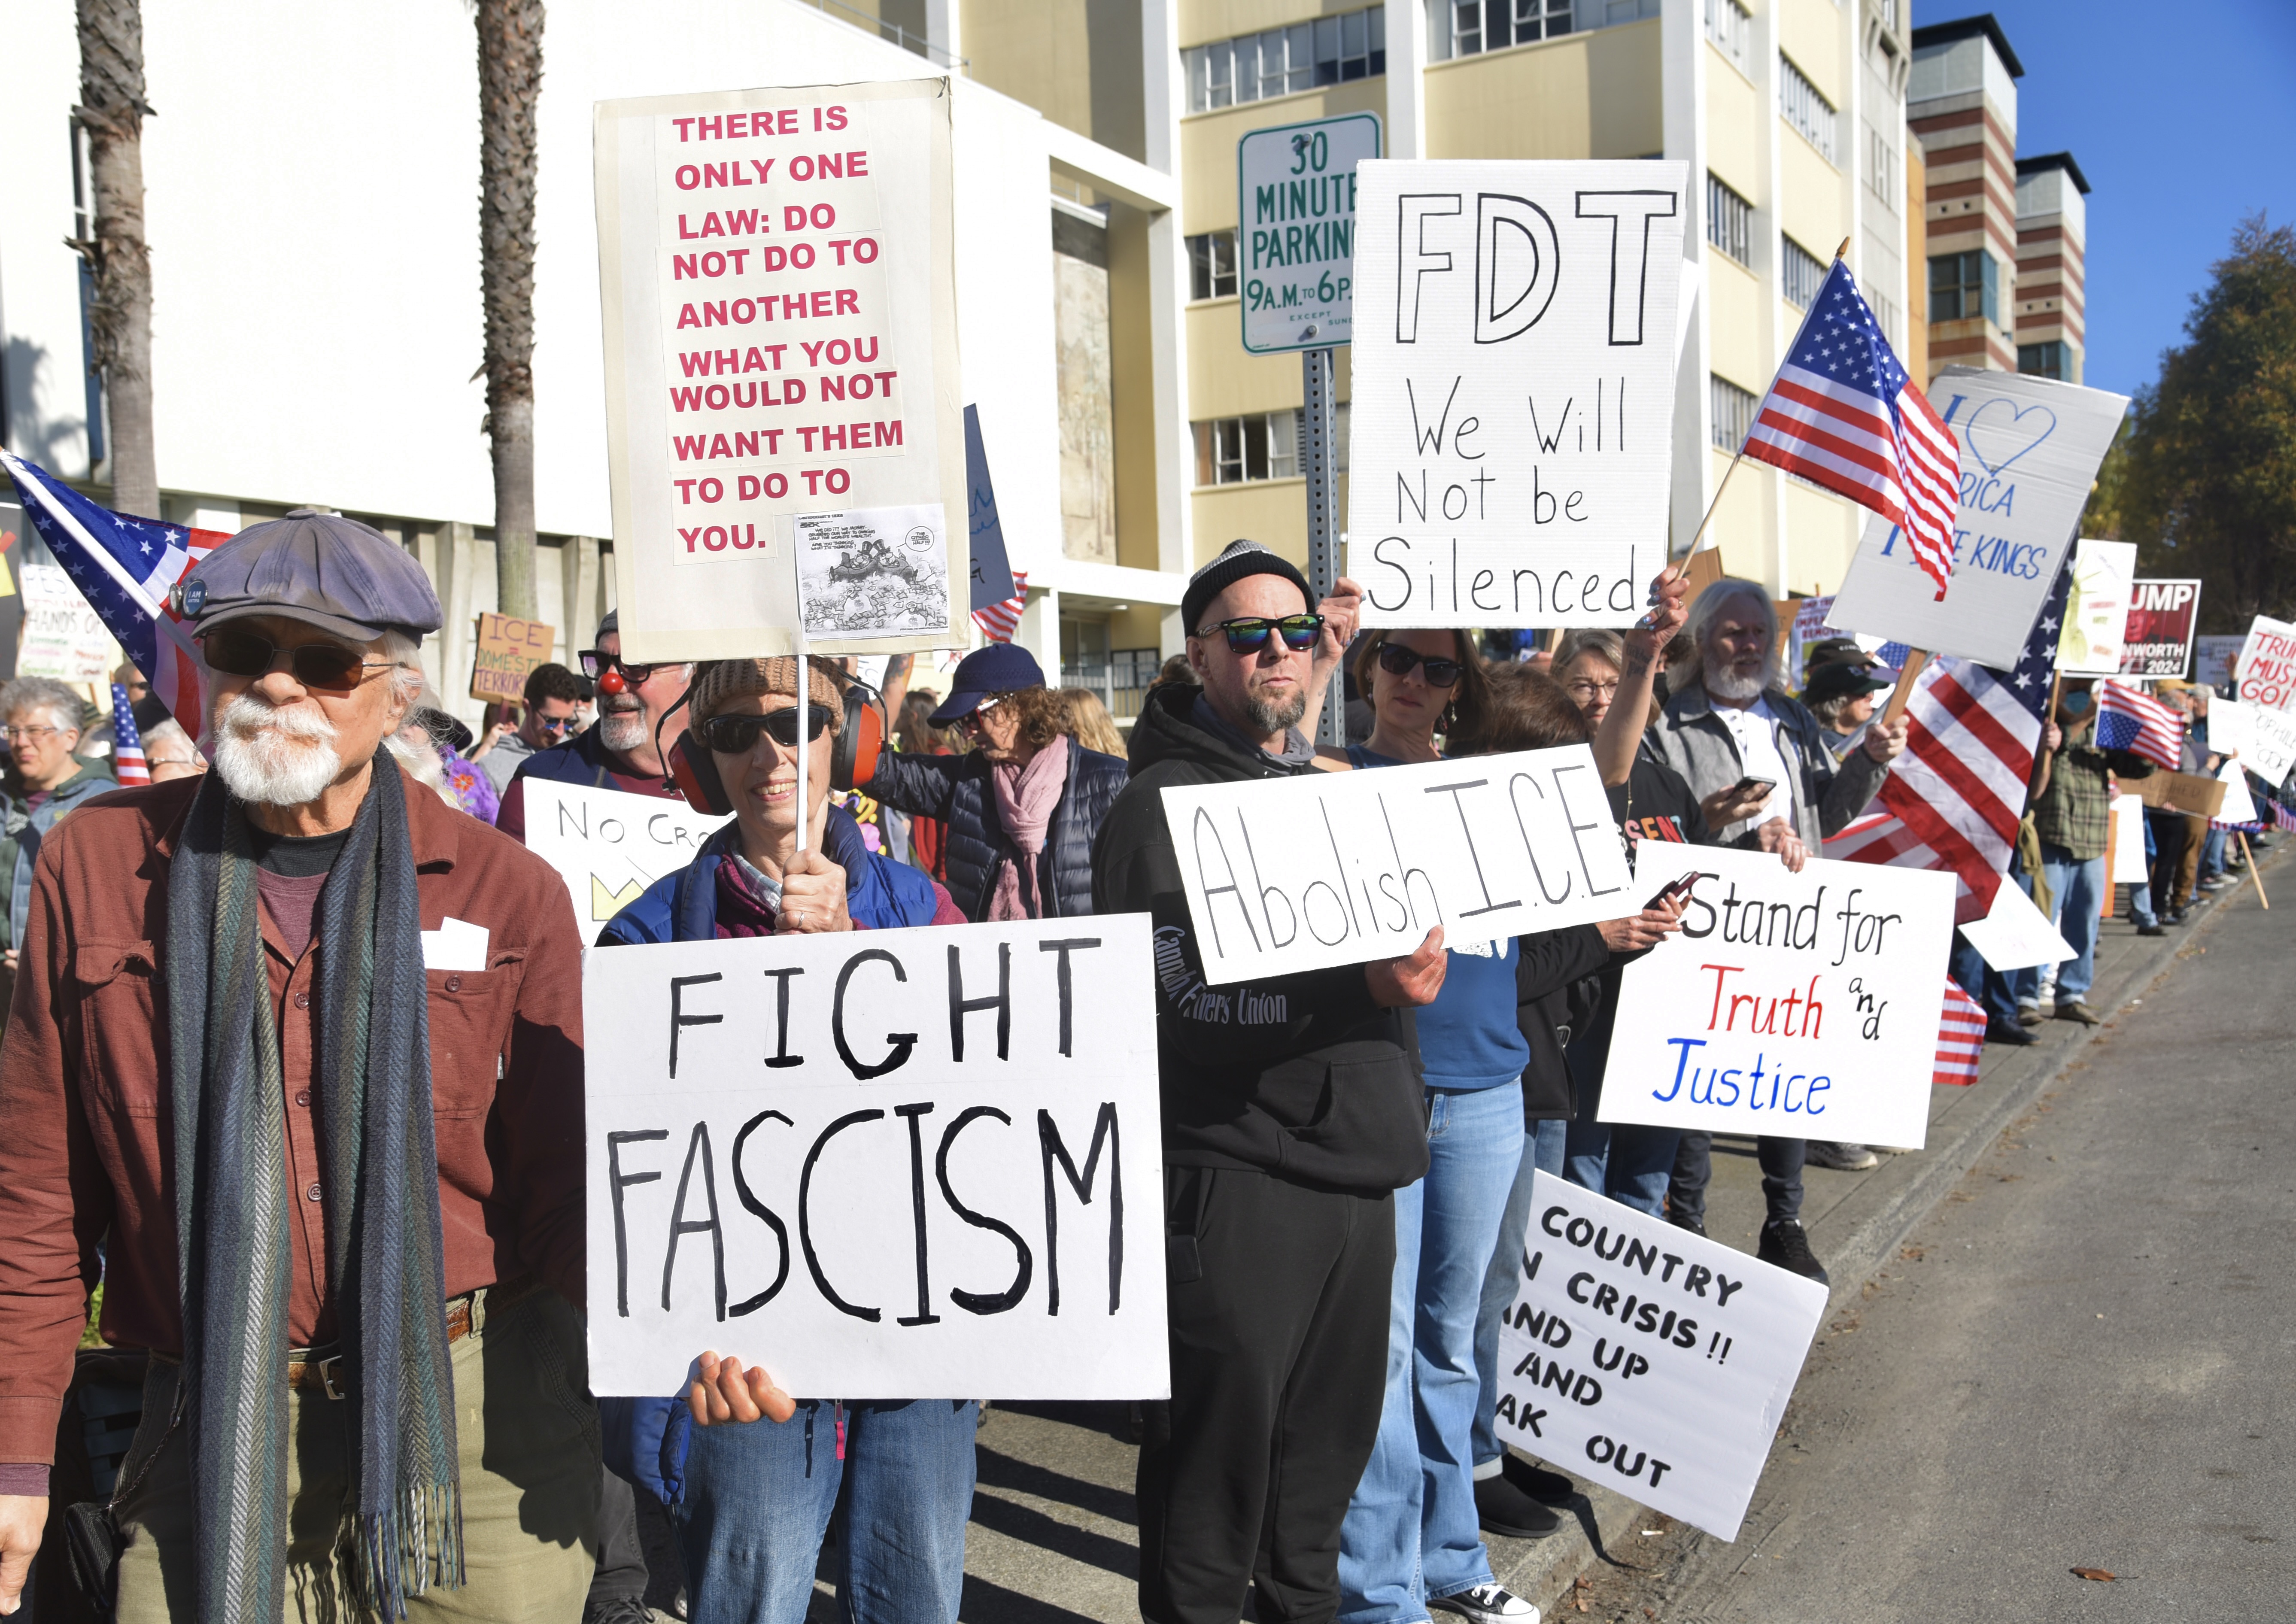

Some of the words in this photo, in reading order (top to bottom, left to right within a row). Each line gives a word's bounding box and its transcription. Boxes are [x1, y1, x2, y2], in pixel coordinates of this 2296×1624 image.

[673, 110, 798, 142] THERE
[814, 106, 847, 131] IS
[676, 159, 774, 190] ONLY
[790, 152, 868, 181] ONE
[1291, 132, 1327, 174] 30
[679, 209, 768, 239] LAW:
[785, 204, 835, 231] DO
[674, 249, 749, 279] NOT
[765, 244, 815, 271] DO
[829, 238, 878, 265] TO
[1253, 219, 1355, 270] PARKIN
[1396, 190, 1677, 346] FDT
[678, 290, 859, 328] ANOTHER
[1302, 288, 1315, 299] TO
[1289, 311, 1331, 321] EXCEPT
[680, 345, 787, 377] WHAT
[801, 337, 878, 366] YOU
[671, 379, 806, 412] WOULD
[821, 372, 896, 401] NOT
[1943, 395, 1967, 425] I
[1406, 376, 1485, 459] We
[1529, 377, 1624, 454] Will
[674, 429, 783, 460] WANT
[797, 421, 902, 452] THEM
[674, 478, 723, 504] TO
[738, 473, 788, 500] DO
[802, 469, 850, 495] TO
[1398, 467, 1495, 523] Not
[1534, 465, 1588, 524] be
[678, 524, 765, 552] YOU.
[1969, 534, 2047, 580] KINGS
[1368, 537, 1634, 613] Silenced
[489, 615, 544, 647] ICE
[479, 648, 544, 674] DOMEST
[2146, 659, 2181, 674] 2024
[2241, 678, 2290, 710] GO!
[1194, 792, 1443, 959] Abolish
[1424, 765, 1630, 918] I.C.E.
[1680, 872, 1827, 950] Stand
[1831, 889, 1901, 966] for
[669, 938, 1102, 1080] FIGHT
[1237, 988, 1288, 1025] Union
[1701, 965, 1822, 1039] Truth
[1850, 978, 1887, 1040] and
[1652, 1038, 1830, 1114] Justice
[607, 1102, 1123, 1327] FASCISM
[1542, 1206, 1742, 1306] COUNTRY
[1513, 1352, 1602, 1405] AND
[1593, 1338, 1649, 1379] UP
[1585, 1436, 1671, 1487] OUT
